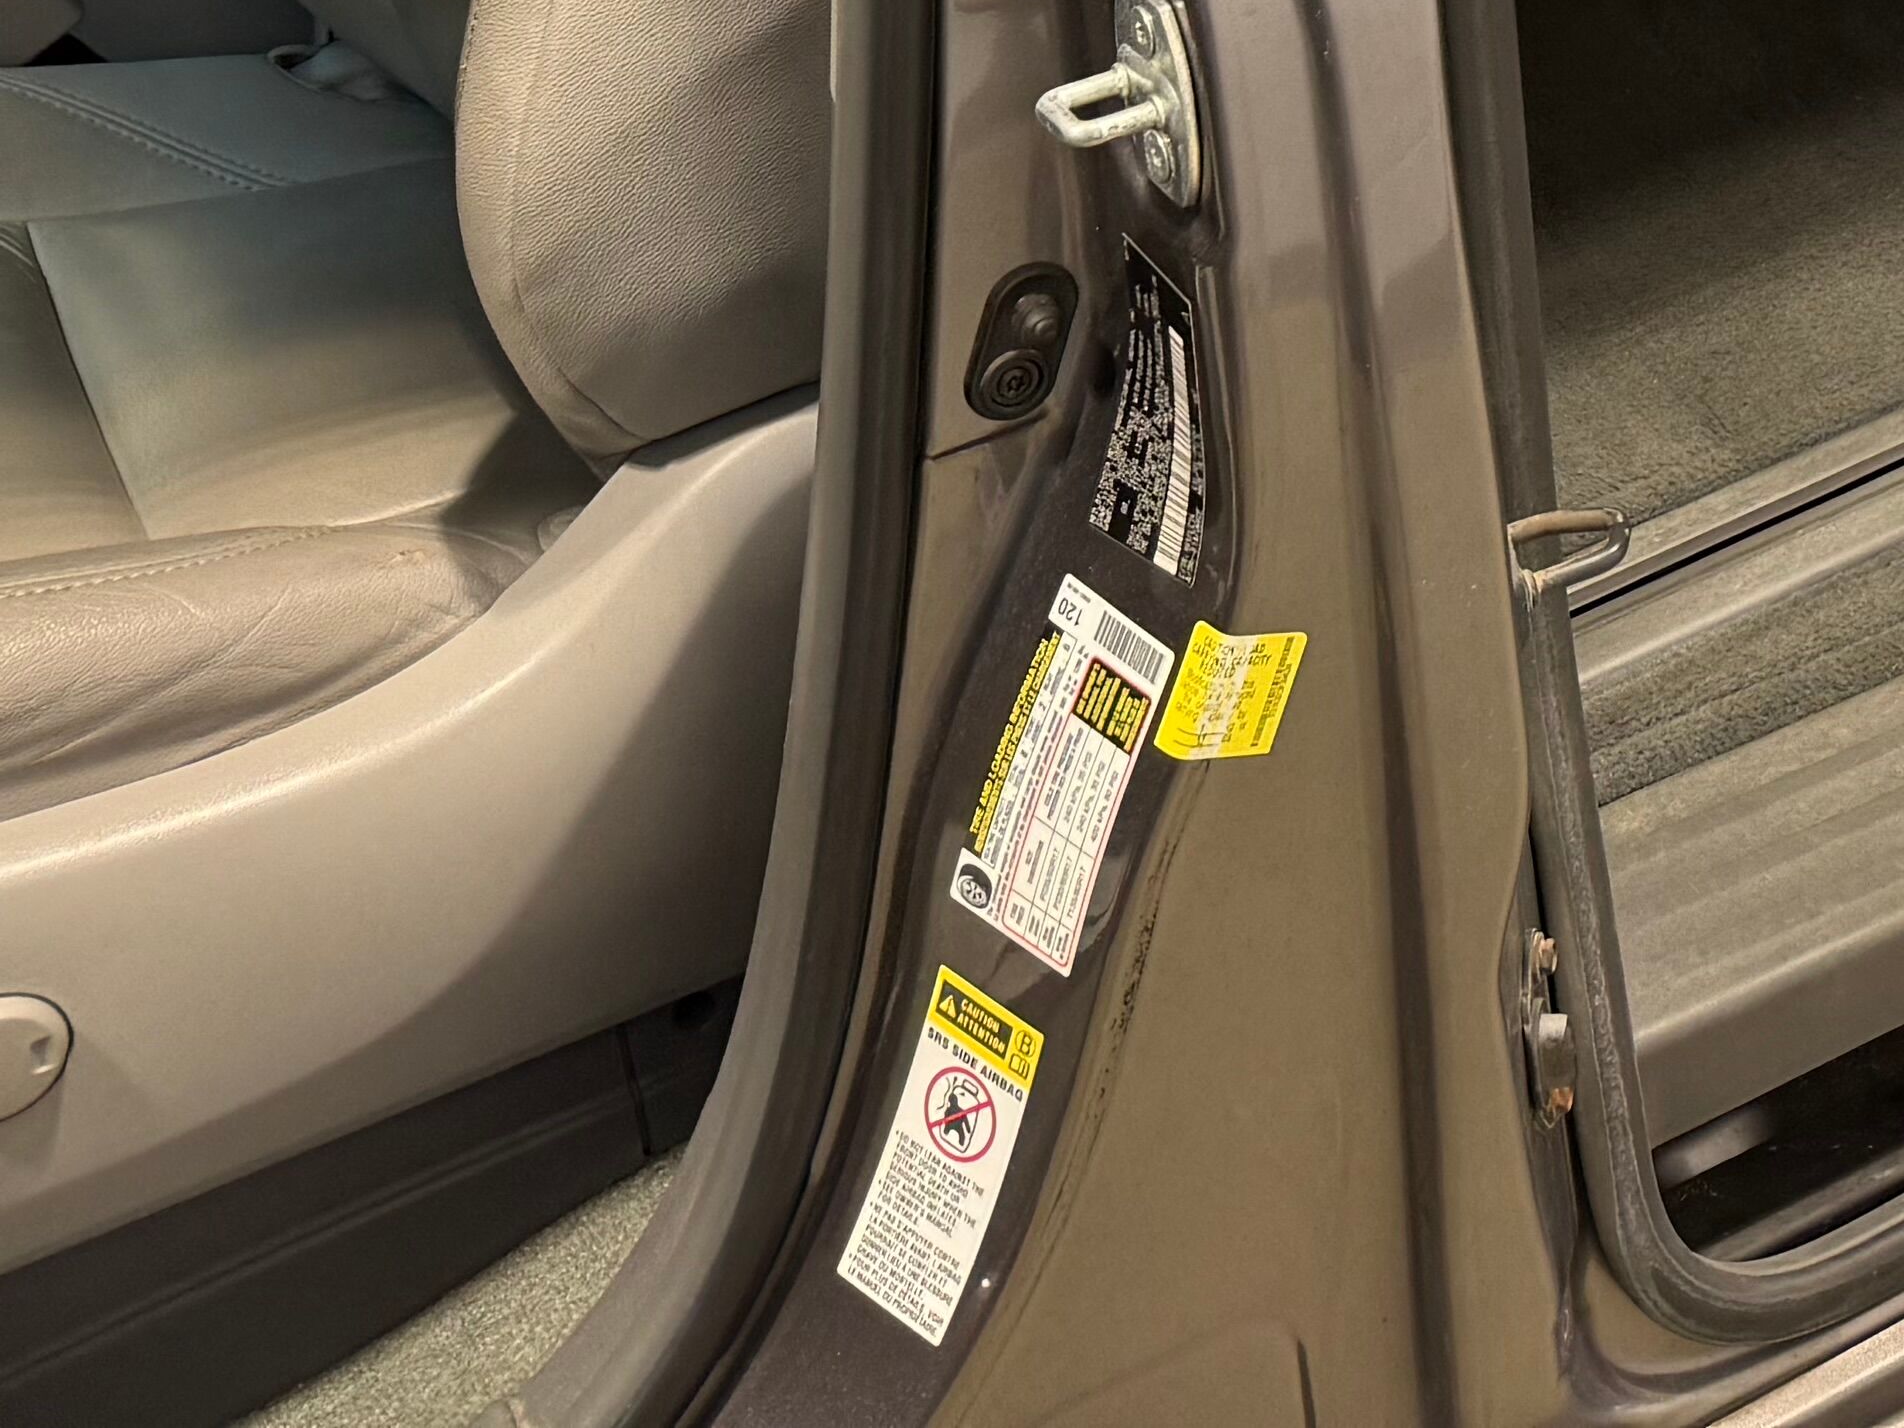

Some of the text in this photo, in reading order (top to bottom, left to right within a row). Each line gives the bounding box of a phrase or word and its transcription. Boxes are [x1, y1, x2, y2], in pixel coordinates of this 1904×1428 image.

[1056, 595, 1084, 627] 120
[968, 805, 985, 836] TIRE
[977, 777, 994, 807] AND
[987, 721, 1014, 781] LOADING
[1008, 636, 1049, 725] INFORMATION
[955, 1010, 1007, 1055] ATTENTION
[959, 997, 1035, 1057] CAUTION B
[926, 1025, 1025, 1103] SRS SIDE AIRBAG
[927, 1174, 950, 1198] DEATH
[941, 1160, 971, 1188] AGAINST
[970, 1181, 984, 1198] THE
